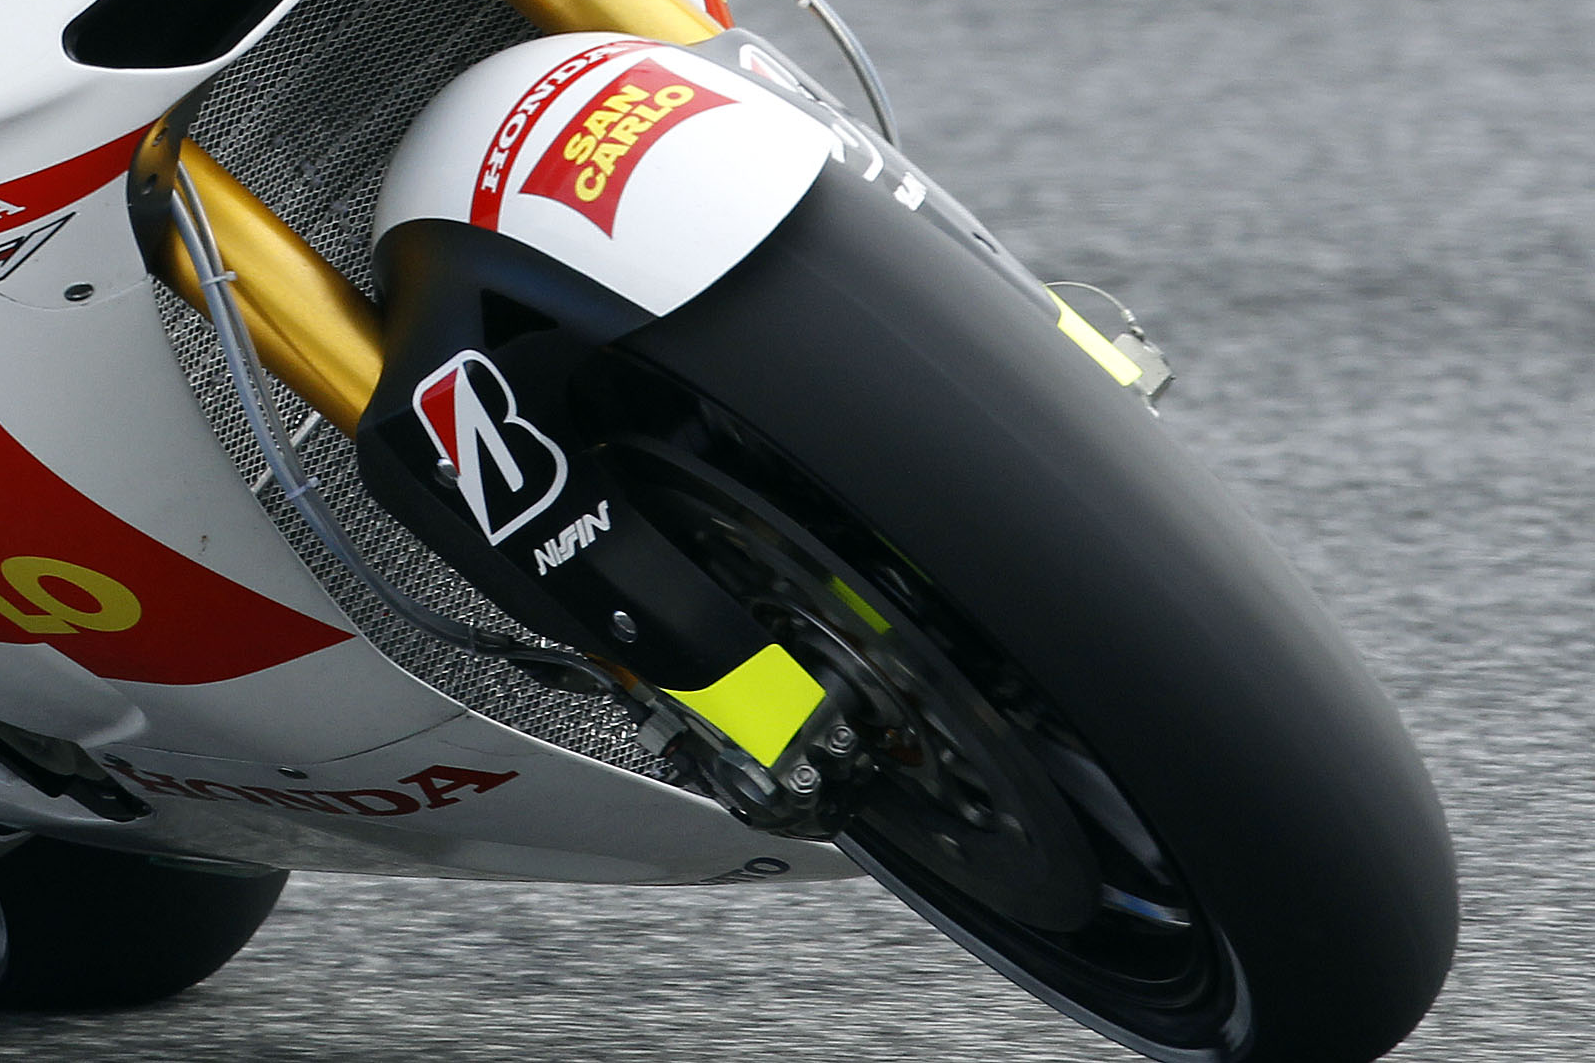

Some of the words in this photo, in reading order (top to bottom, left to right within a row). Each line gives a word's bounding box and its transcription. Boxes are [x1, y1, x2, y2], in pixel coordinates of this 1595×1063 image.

[481, 46, 632, 194] HONDA
[562, 84, 651, 166] SAN
[574, 84, 695, 203] CARLO
[103, 765, 522, 818] HONDA
